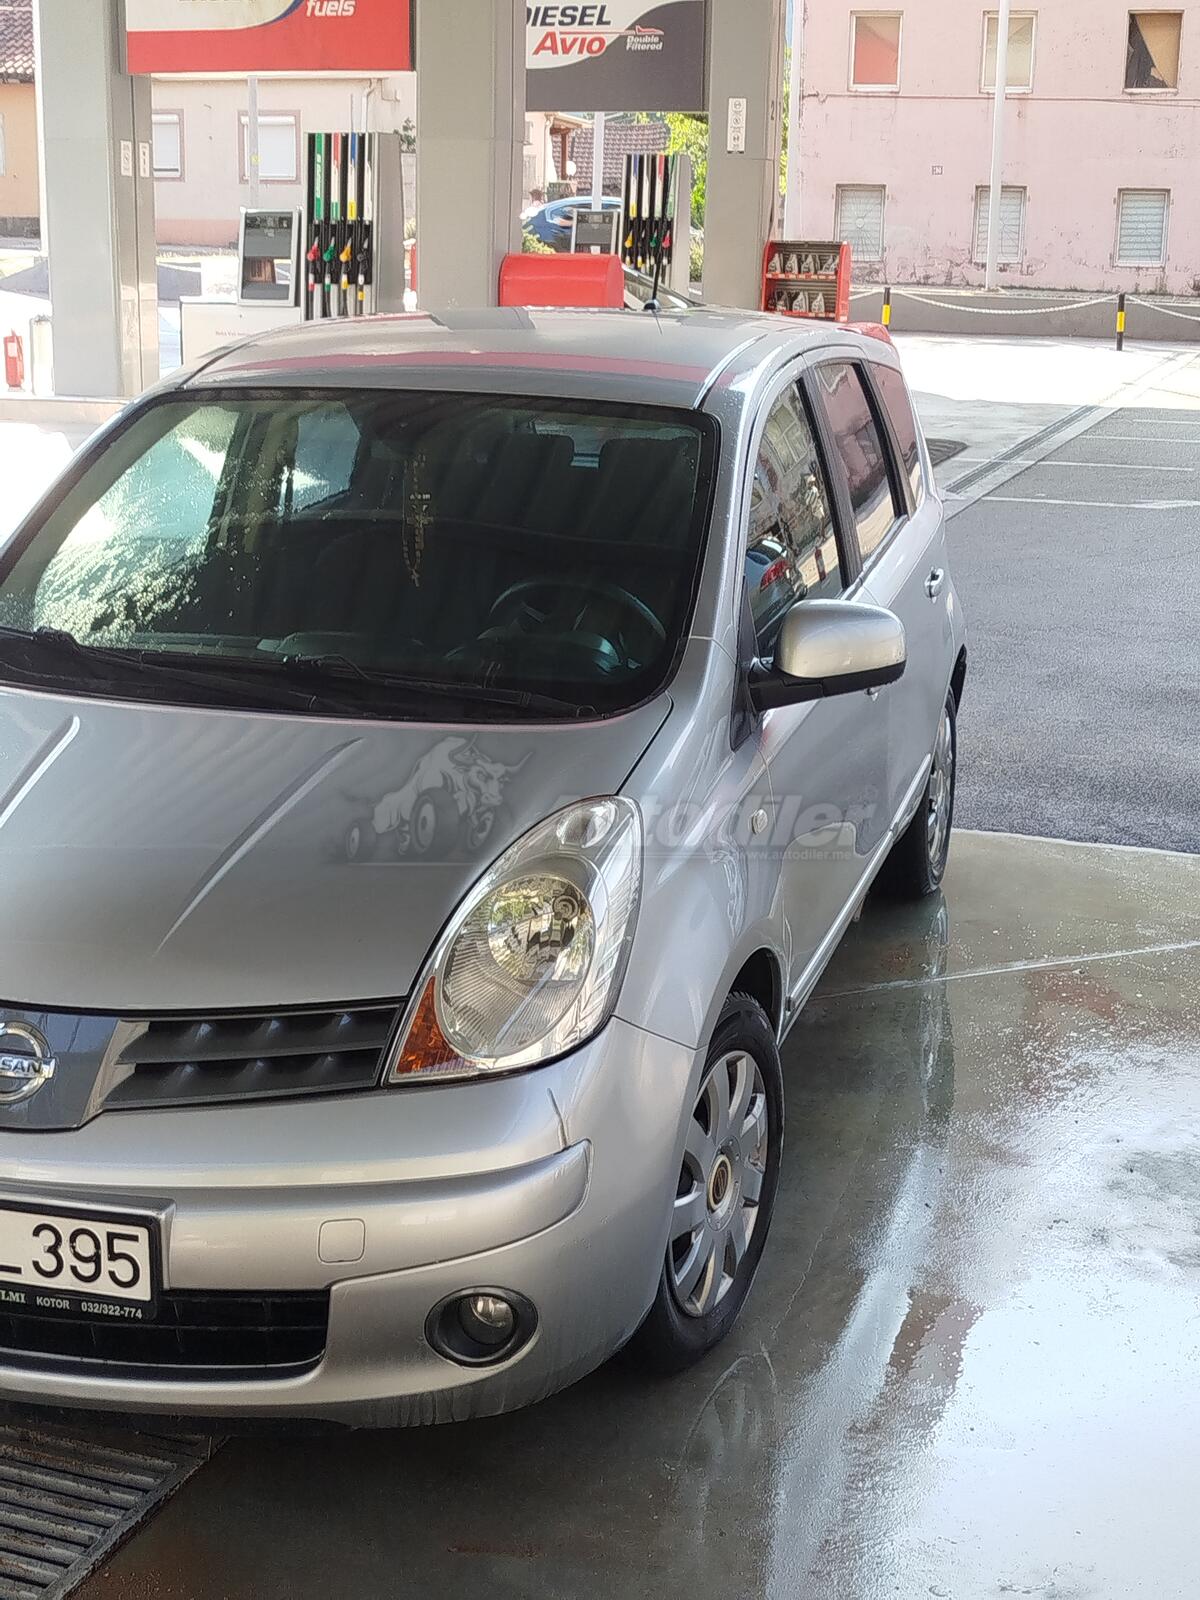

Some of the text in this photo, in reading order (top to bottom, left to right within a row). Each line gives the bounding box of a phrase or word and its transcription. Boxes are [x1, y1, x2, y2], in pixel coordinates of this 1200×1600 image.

[306, 0, 356, 17] fuels
[627, 35, 660, 44] Double
[626, 42, 663, 51] Filtered
[36, 1295, 71, 1310] KOTOR
[81, 1301, 143, 1320] 032/322-774
